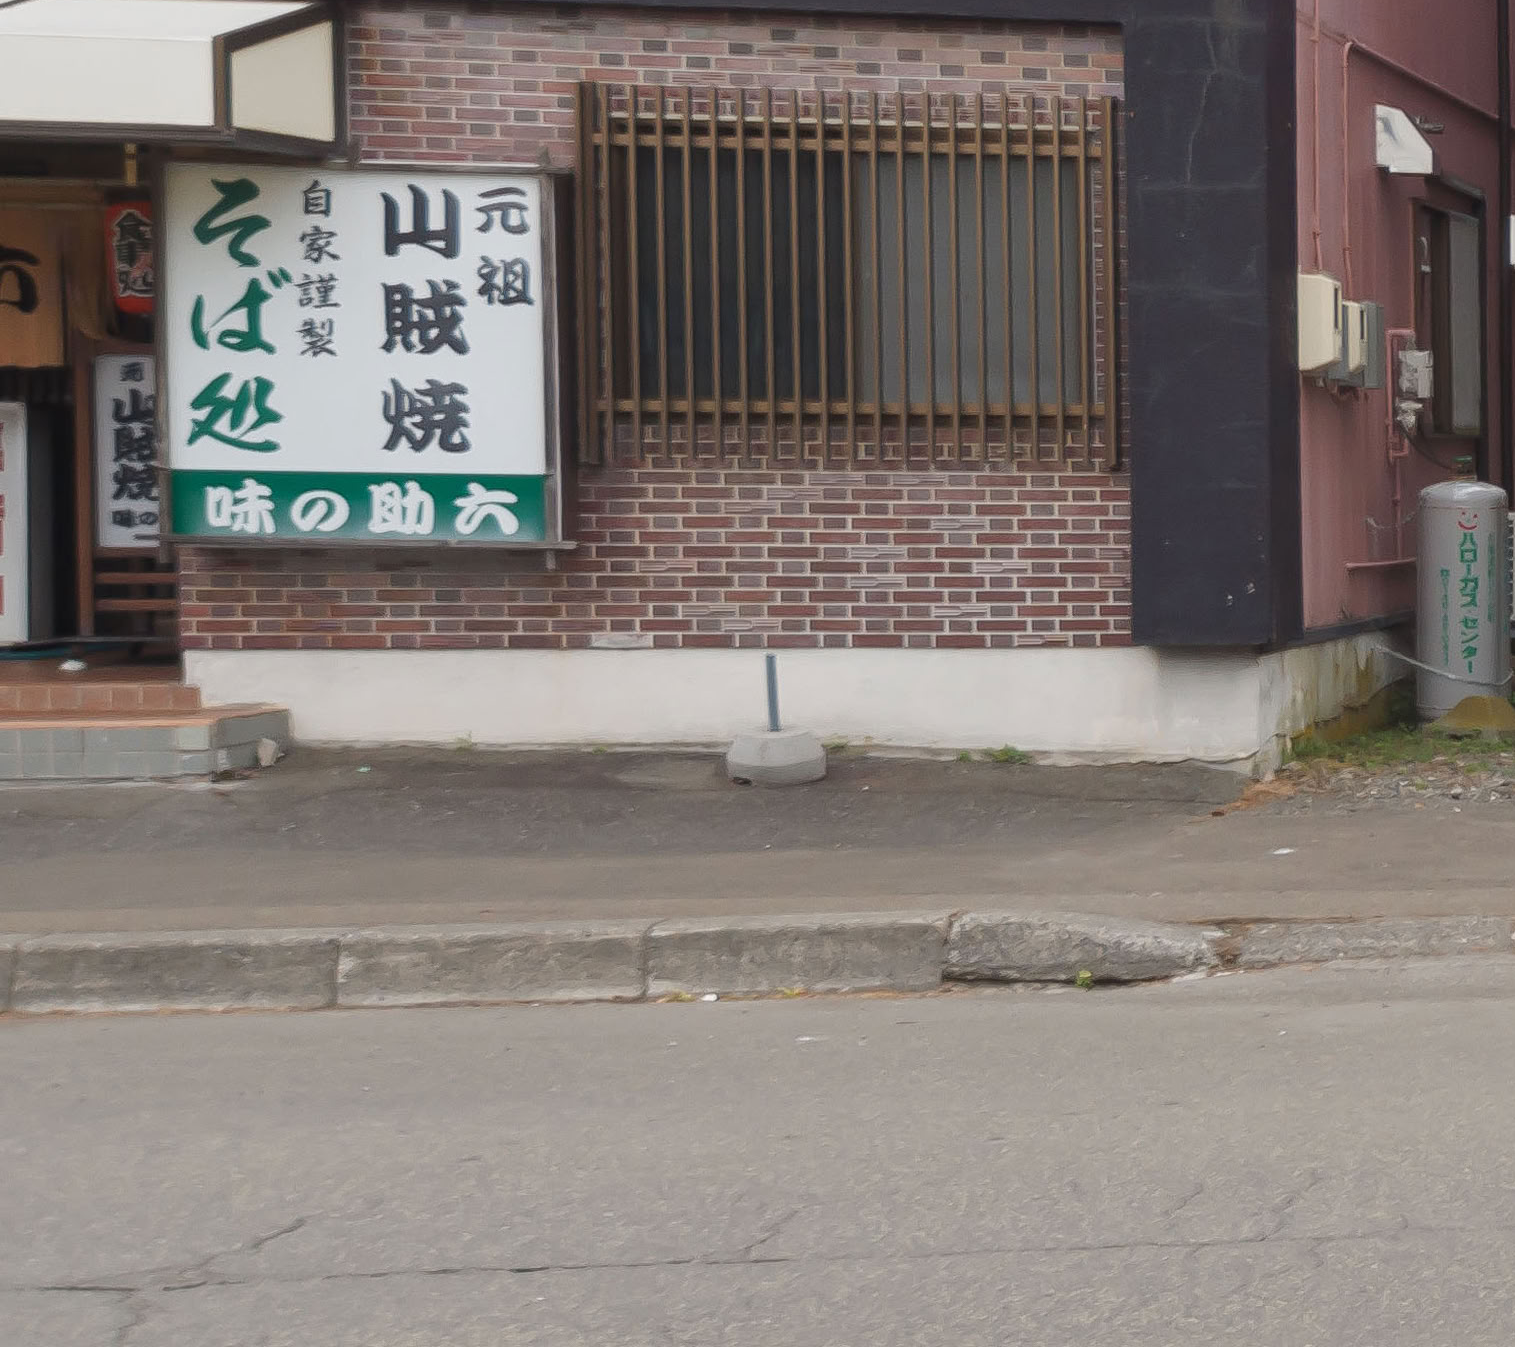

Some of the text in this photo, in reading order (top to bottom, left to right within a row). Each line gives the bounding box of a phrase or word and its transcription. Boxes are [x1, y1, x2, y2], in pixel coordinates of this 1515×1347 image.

[187, 178, 293, 453] そば処
[295, 179, 342, 357] 自家謹製
[380, 184, 472, 454] 山賊焼
[475, 186, 535, 306] 元祖
[203, 478, 520, 536] 味の助六
